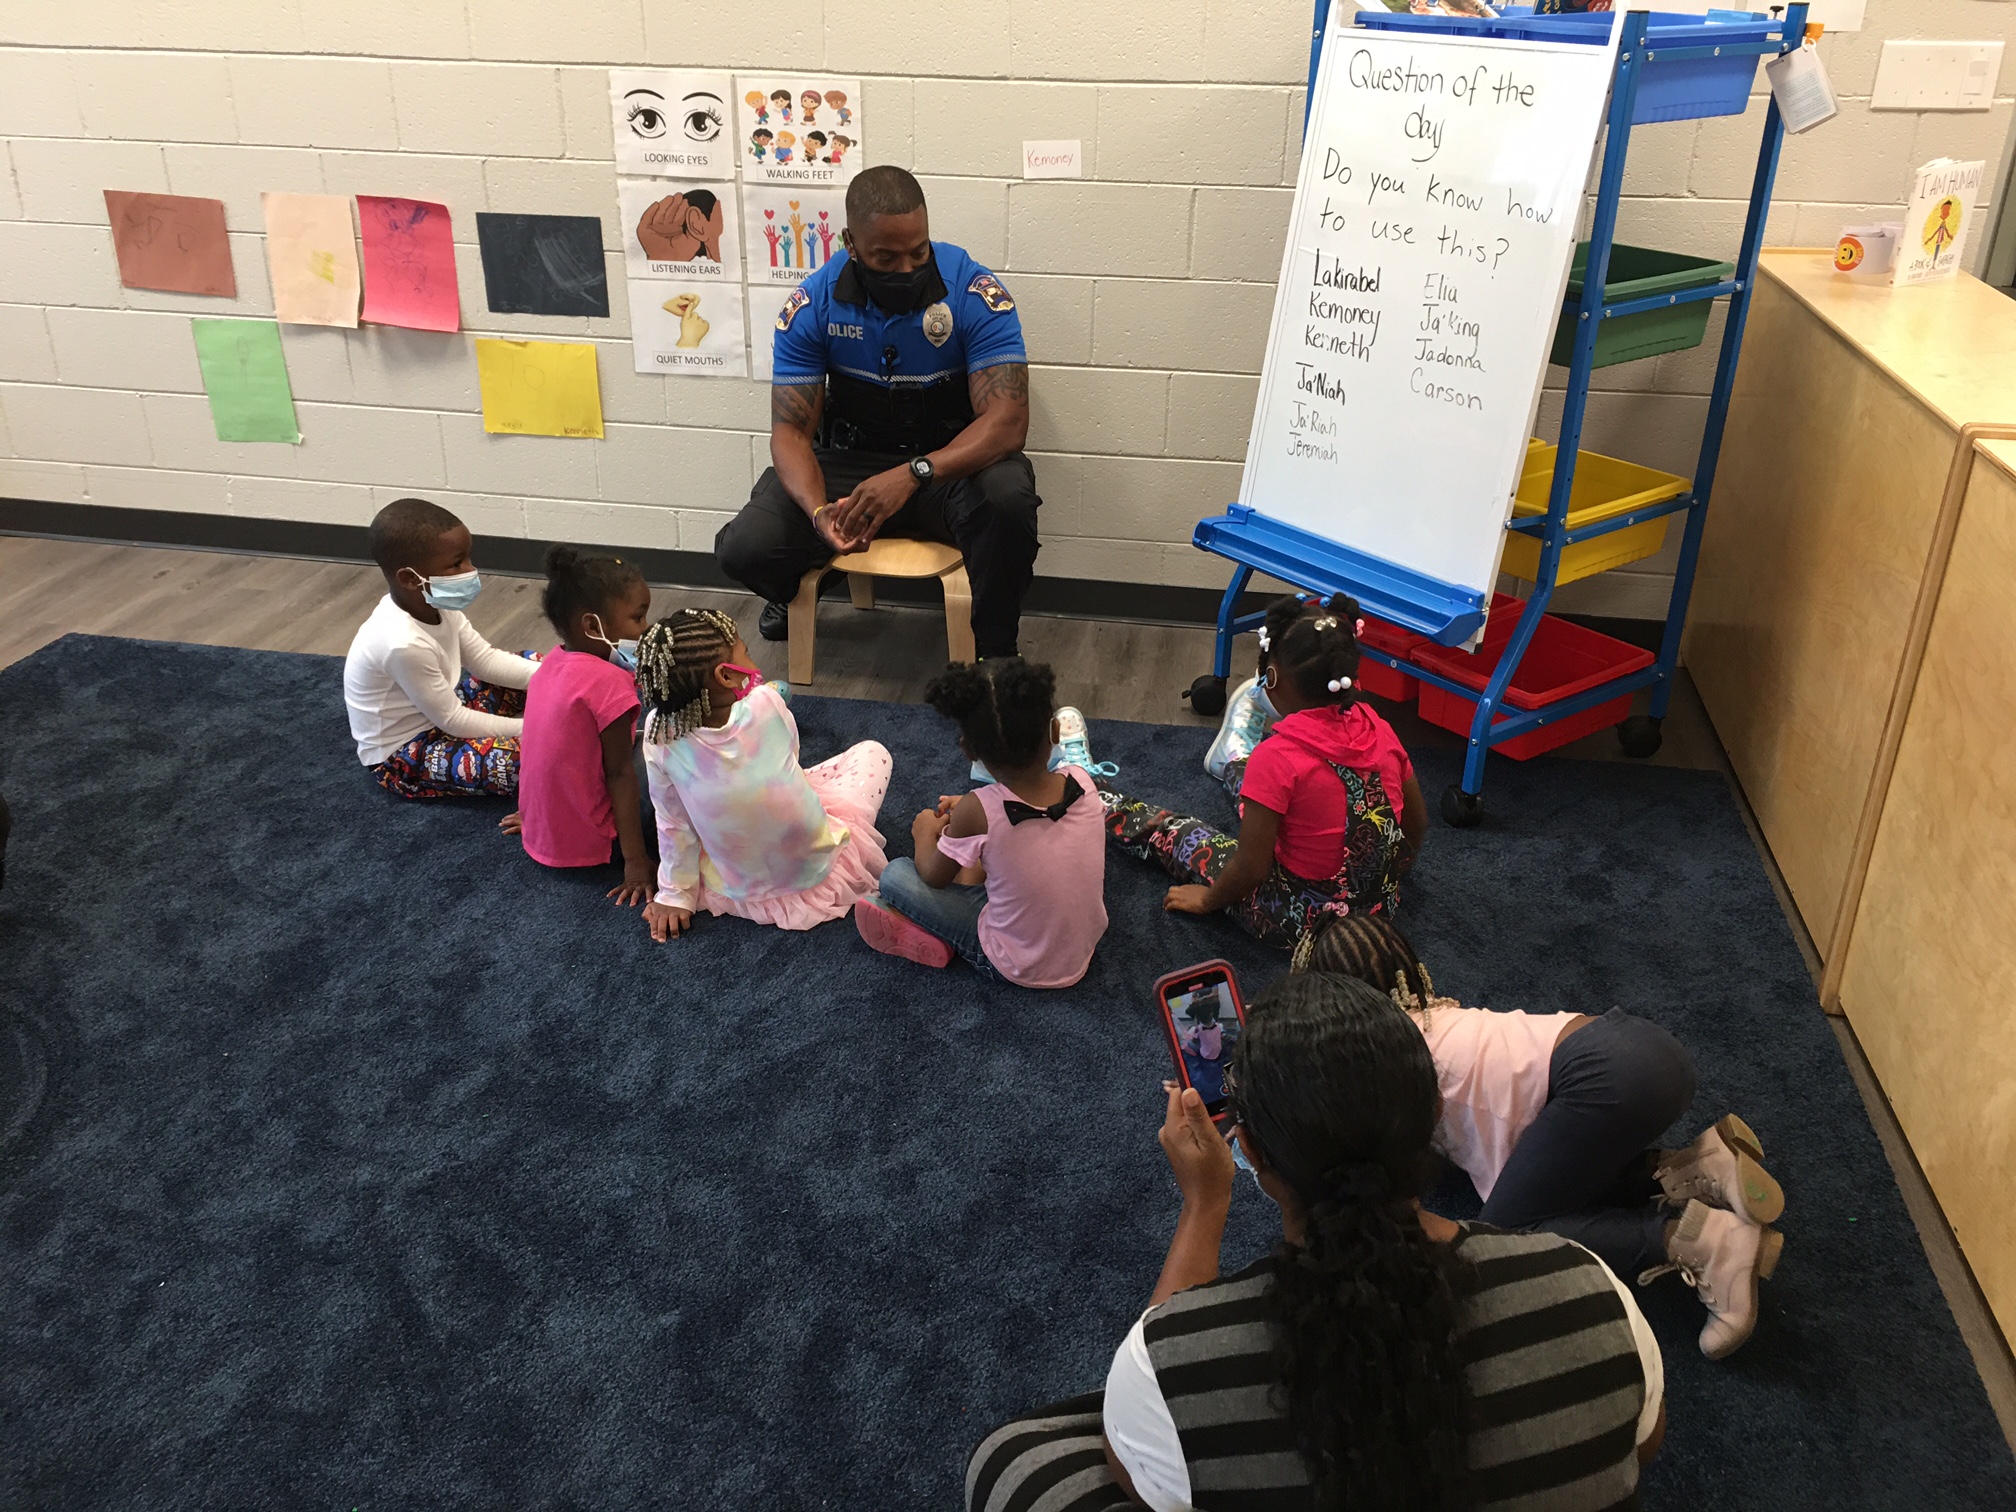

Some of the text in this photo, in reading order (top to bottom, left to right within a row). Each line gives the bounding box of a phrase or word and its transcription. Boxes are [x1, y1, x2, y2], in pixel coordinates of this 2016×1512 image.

[1349, 49, 1535, 107] Question of the
[1404, 103, 1446, 163] day
[644, 153, 709, 165] LOOKING EYES
[766, 168, 834, 180] WALKING FEET
[1027, 149, 1074, 168] Kemoney
[1323, 147, 1352, 184] Do
[1368, 172, 1406, 206] you
[1507, 187, 1554, 224] how
[1919, 165, 1983, 199] I AM HUMAN
[1319, 197, 1510, 280] to use this?
[651, 264, 721, 275] LISTENING EARS
[827, 322, 864, 340] OLICE
[1309, 290, 1382, 347] Kemoney
[656, 354, 724, 366] QUIET MOUTHS
[1295, 361, 1346, 406] Ja'Niah
[1410, 366, 1483, 411] Carson
[1290, 400, 1337, 437] Ja'Riah
[1286, 431, 1338, 464] Jeremiah
[497, 758, 508, 786] BANG
